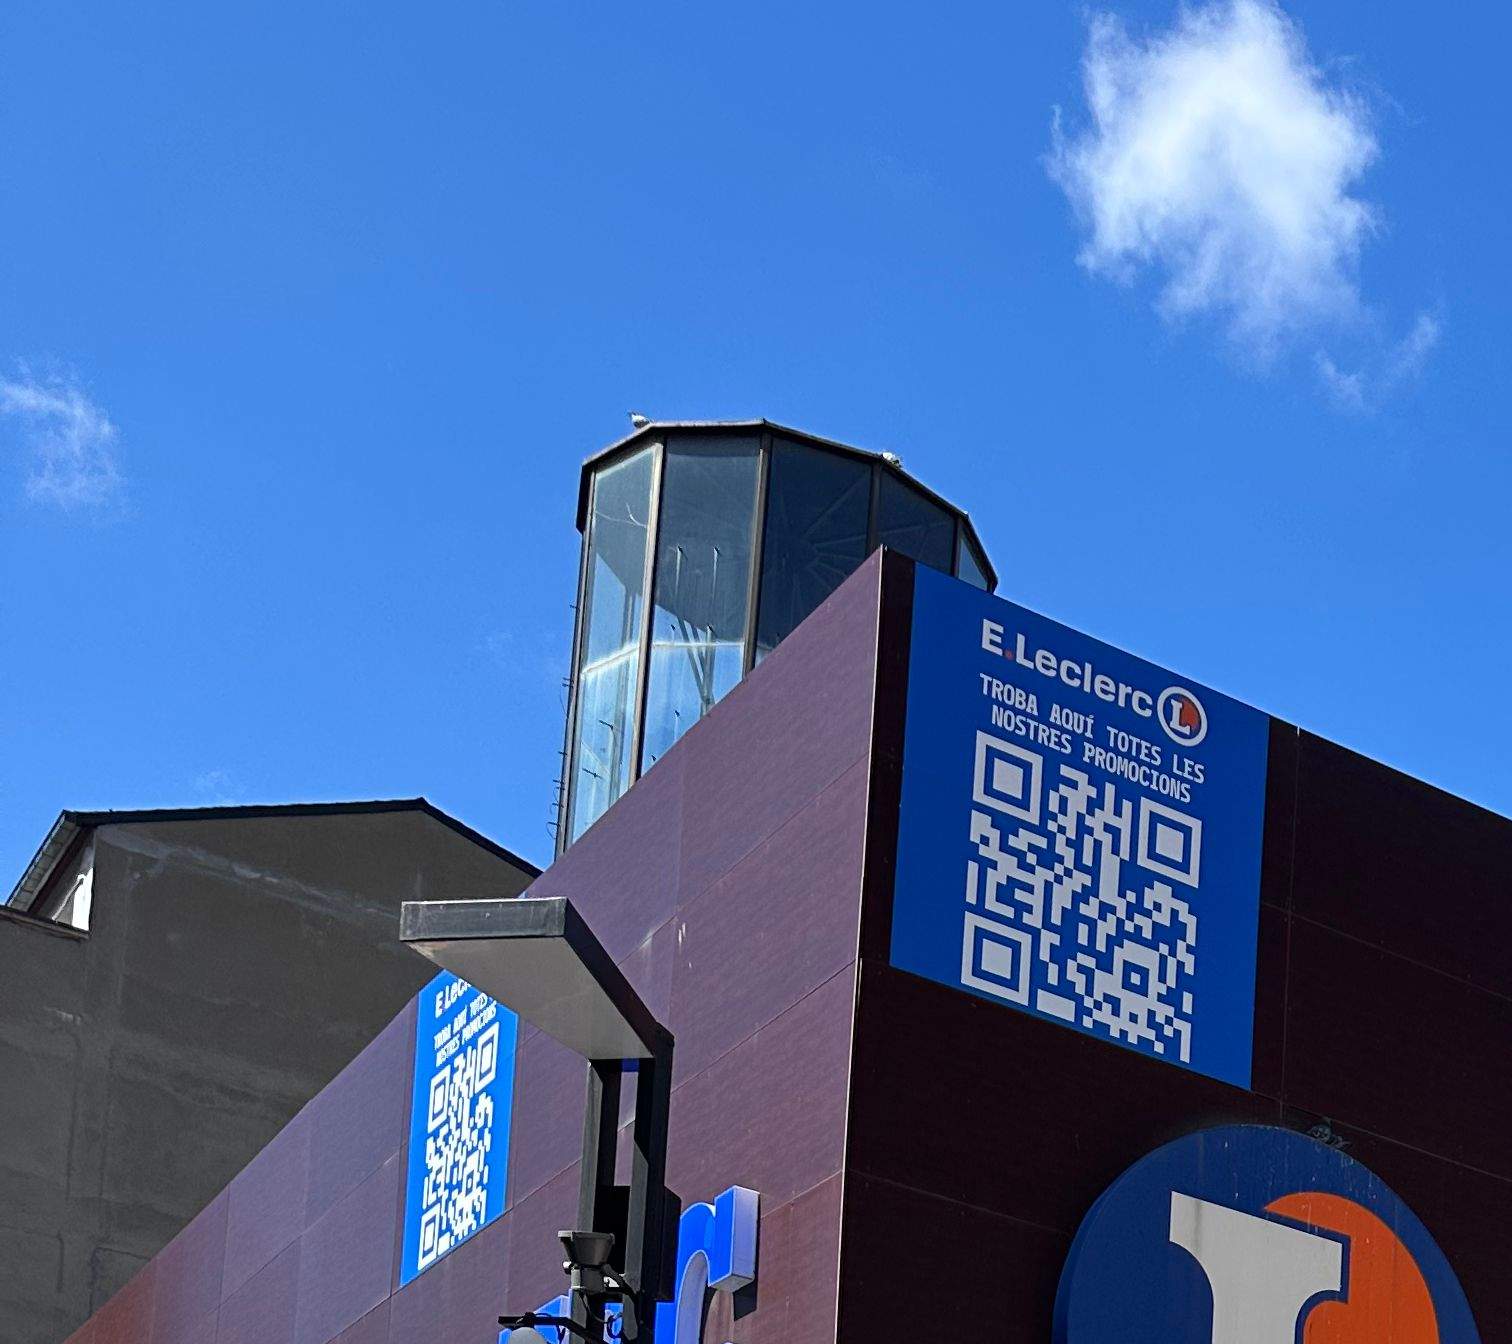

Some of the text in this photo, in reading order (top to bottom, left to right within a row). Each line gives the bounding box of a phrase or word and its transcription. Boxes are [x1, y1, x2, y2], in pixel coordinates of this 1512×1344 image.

[981, 618, 1153, 718] E.Leclerc
[979, 672, 1205, 784] TROBA AQUÍ TOTES LES
[991, 704, 1191, 803] NOSTRES PROMOCIONS
